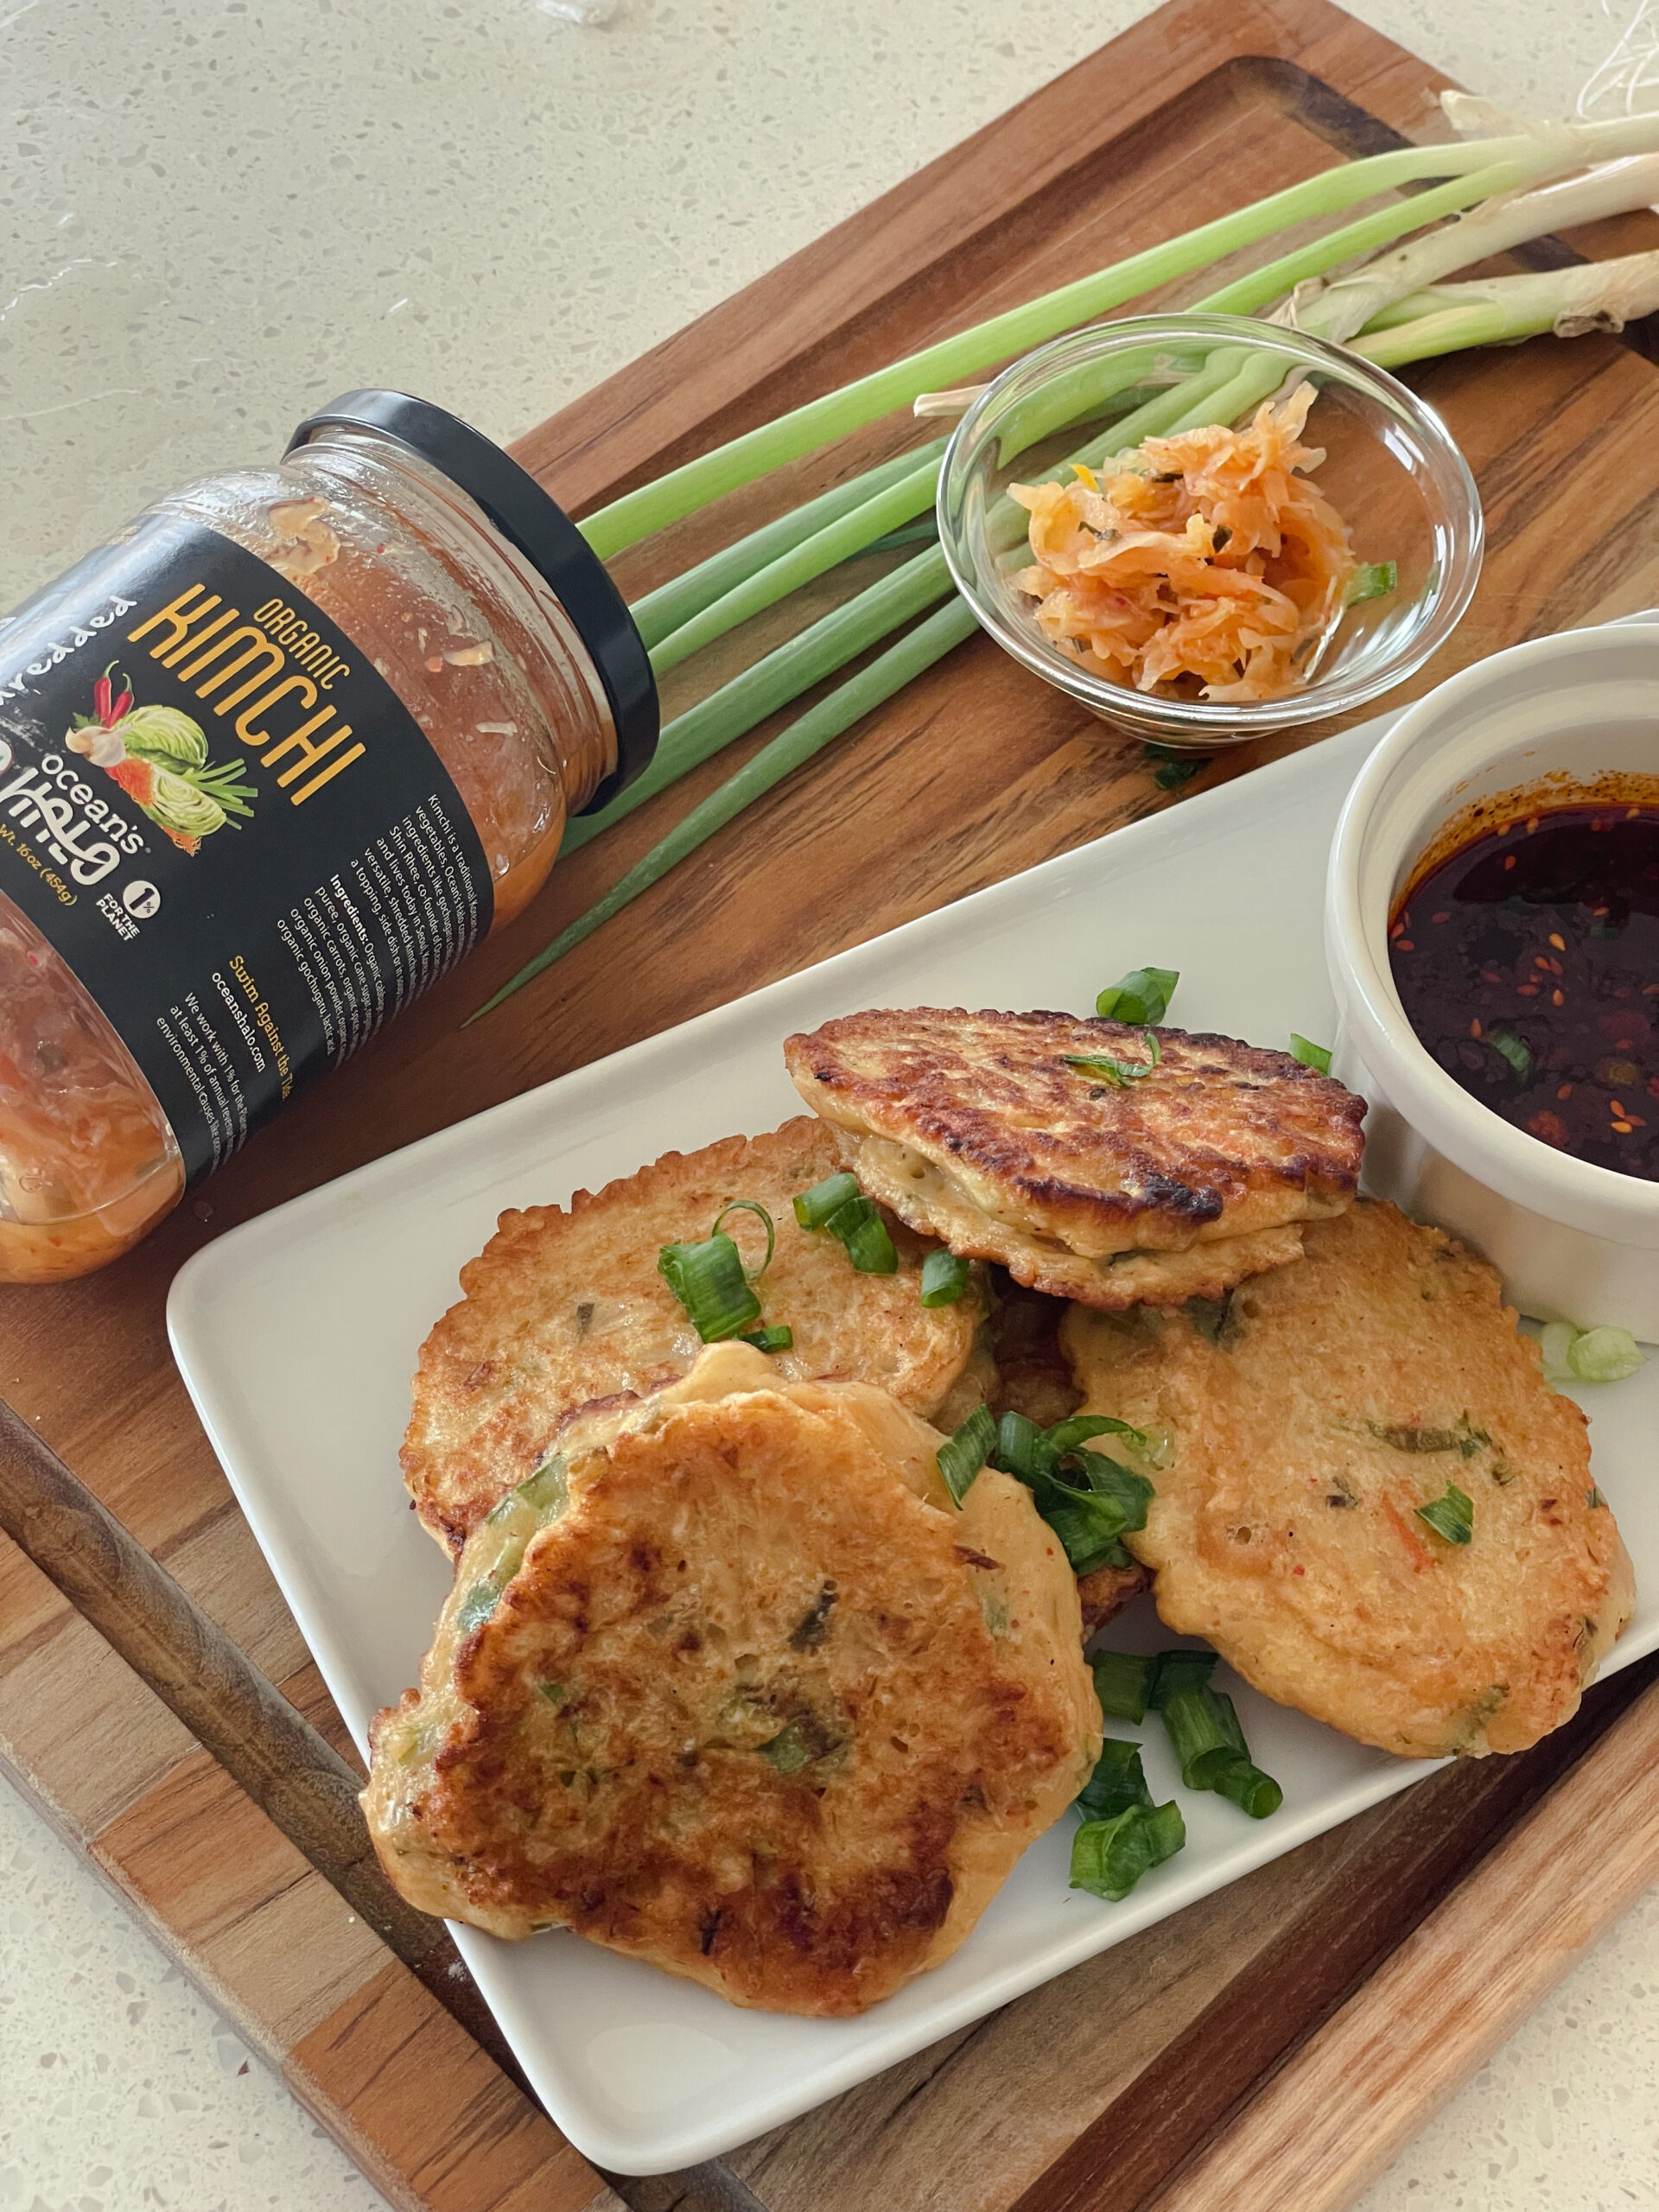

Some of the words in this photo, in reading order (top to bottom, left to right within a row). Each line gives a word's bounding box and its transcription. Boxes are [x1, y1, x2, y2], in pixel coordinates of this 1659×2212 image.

[253, 598, 350, 690] ORGANIC
[127, 582, 366, 807] KIMCHI
[41, 754, 143, 855] ocean's
[428, 794, 453, 834] Kimchi
[377, 838, 394, 861] and
[403, 815, 435, 877] ingredients
[448, 832, 456, 844] is
[452, 844, 459, 853] a
[40, 868, 78, 906] (454g)
[389, 859, 405, 886] lives
[390, 826, 406, 853] Shin
[404, 852, 420, 884] Rhee,
[418, 884, 438, 935] co-founder
[433, 935, 442, 945] of
[416, 806, 447, 868] vegetables,
[445, 866, 463, 904] Ocean's
[455, 901, 466, 925] Halo
[432, 875, 442, 896] like
[455, 851, 477, 902] traditional
[356, 868, 381, 915] topping,
[365, 848, 391, 898] versatile,
[389, 897, 412, 944] shredded
[405, 940, 416, 972] kimchi
[402, 885, 420, 915] today
[96, 899, 133, 941] PLANET
[103, 893, 124, 917] FOR
[120, 913, 141, 938] THE
[330, 874, 368, 944] Ingredients:
[365, 943, 381, 982] Organic
[378, 914, 391, 936] side
[413, 914, 423, 926] in
[436, 896, 452, 943] gochugaru
[304, 898, 330, 940] organic
[327, 940, 346, 978] carrots,
[342, 977, 358, 1012] organic
[315, 887, 339, 923] puree,
[337, 923, 359, 962] organic
[354, 962, 365, 985] cane
[361, 984, 371, 1010] sugar,
[388, 937, 400, 957] dish
[416, 925, 429, 955] Seoul,
[277, 920, 304, 962] organic
[298, 962, 331, 1017] gochugaru,
[322, 1014, 334, 1039] lactic
[291, 909, 317, 950] organic
[314, 950, 331, 981] onion
[325, 981, 343, 1019] powder,
[393, 957, 403, 967] or
[396, 964, 404, 977] in
[170, 1006, 182, 1020] at
[179, 1017, 199, 1046] least
[213, 973, 265, 1072] oceanshalo.com
[230, 956, 258, 1003] Swim
[255, 1002, 284, 1057] Against
[277, 1054, 289, 1077] the
[185, 992, 199, 1014] We
[197, 1014, 217, 1042] work
[213, 1041, 228, 1066] with
[222, 1065, 236, 1082] 1%
[230, 1080, 240, 1095] for
[235, 1094, 245, 1111] the
[195, 1045, 209, 1064] 1%
[204, 1065, 217, 1075] of
[157, 1018, 206, 1094] environmental
[210, 1120, 219, 1139] like
[209, 1076, 229, 1108] annual
